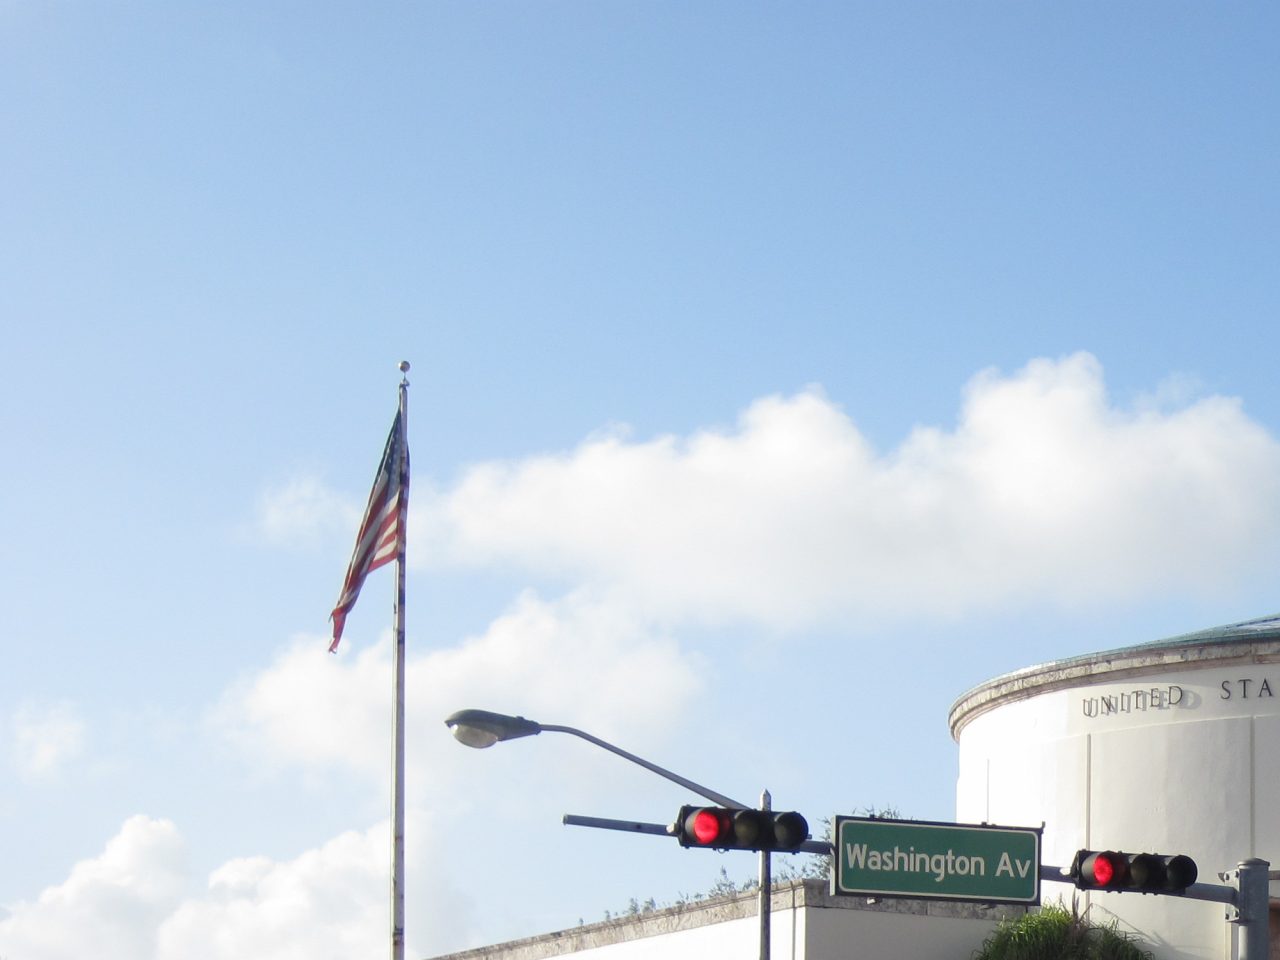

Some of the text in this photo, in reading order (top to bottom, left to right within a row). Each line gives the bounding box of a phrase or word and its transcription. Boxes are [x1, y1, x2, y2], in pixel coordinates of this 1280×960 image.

[1083, 686, 1183, 717] UNITED
[846, 843, 1031, 882] Washington Av
